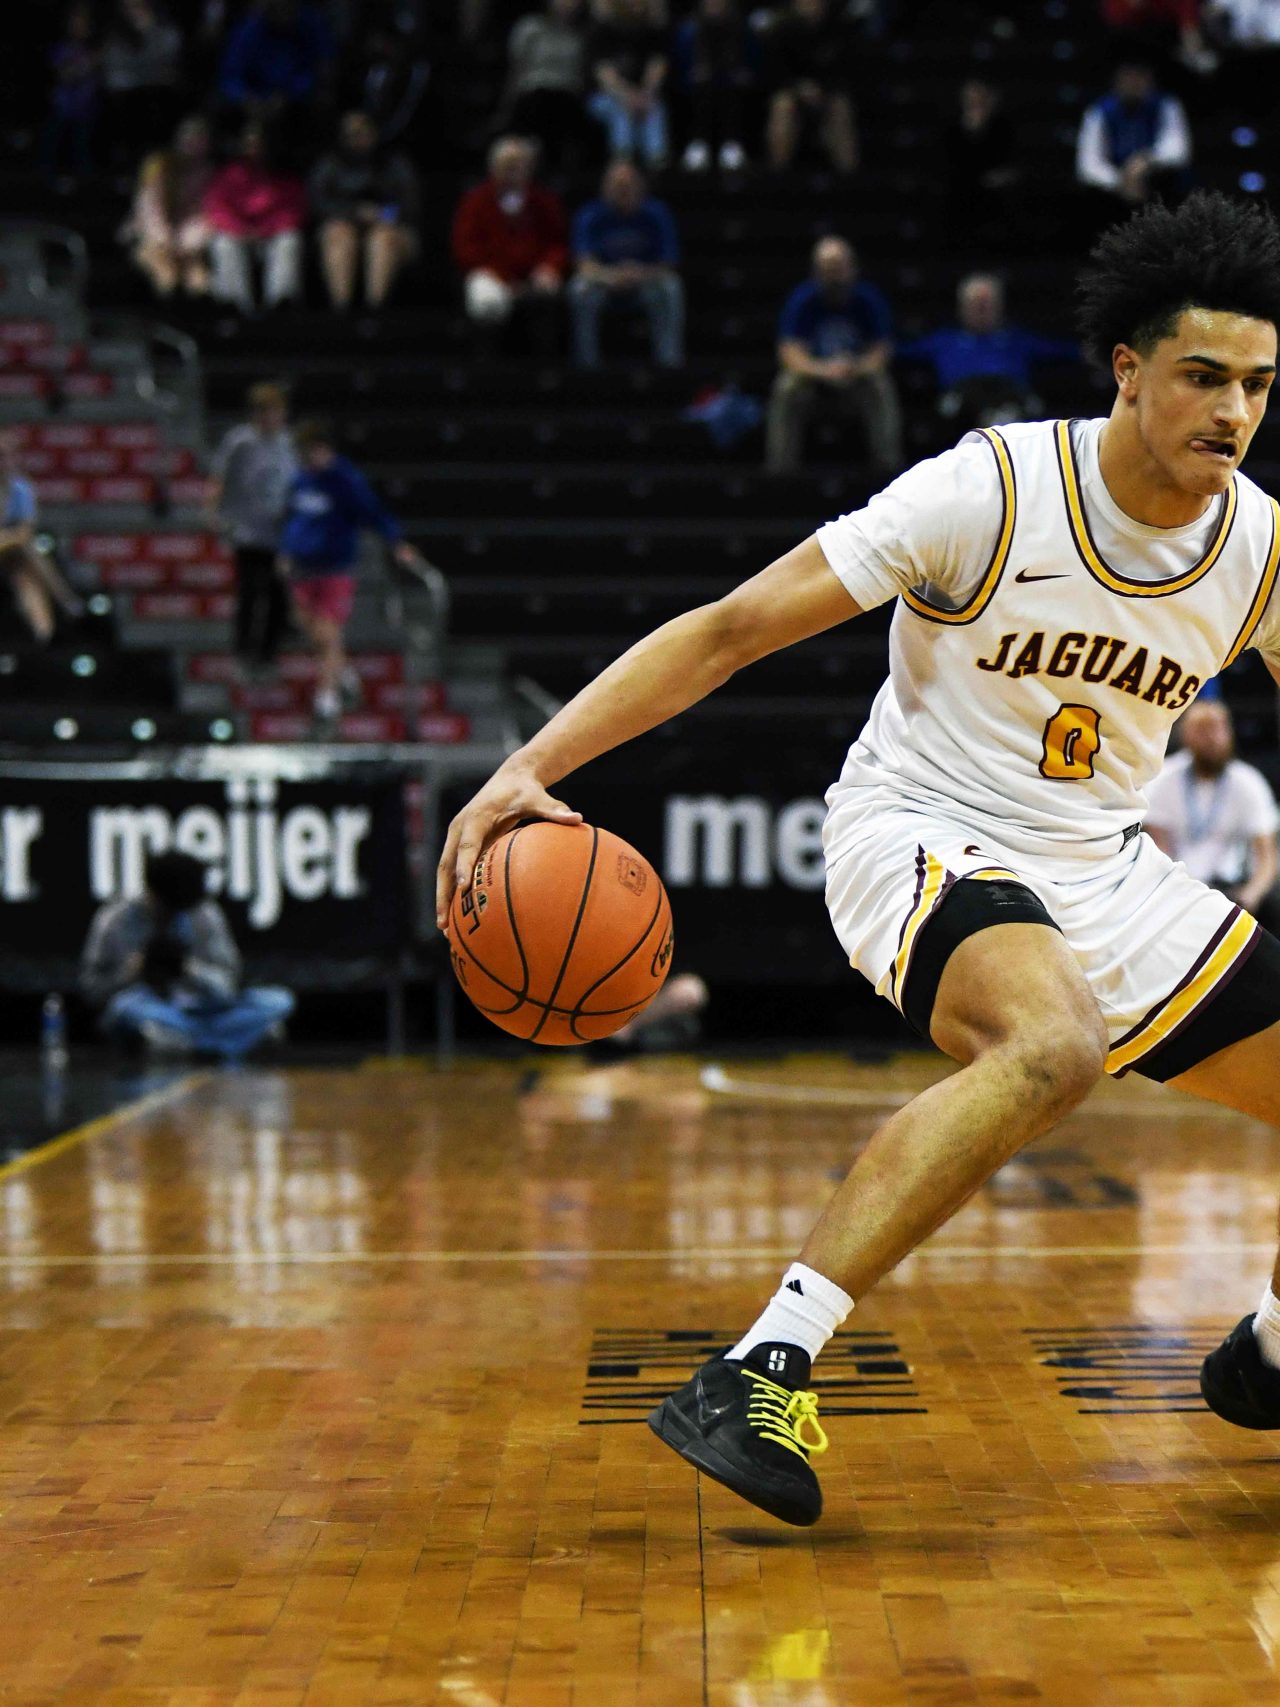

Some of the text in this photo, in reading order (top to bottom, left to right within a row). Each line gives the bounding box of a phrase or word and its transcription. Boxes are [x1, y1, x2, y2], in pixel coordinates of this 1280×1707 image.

[976, 631, 1201, 710] JAGUARS
[1038, 702, 1102, 781] 0
[91, 778, 371, 929] meijer
